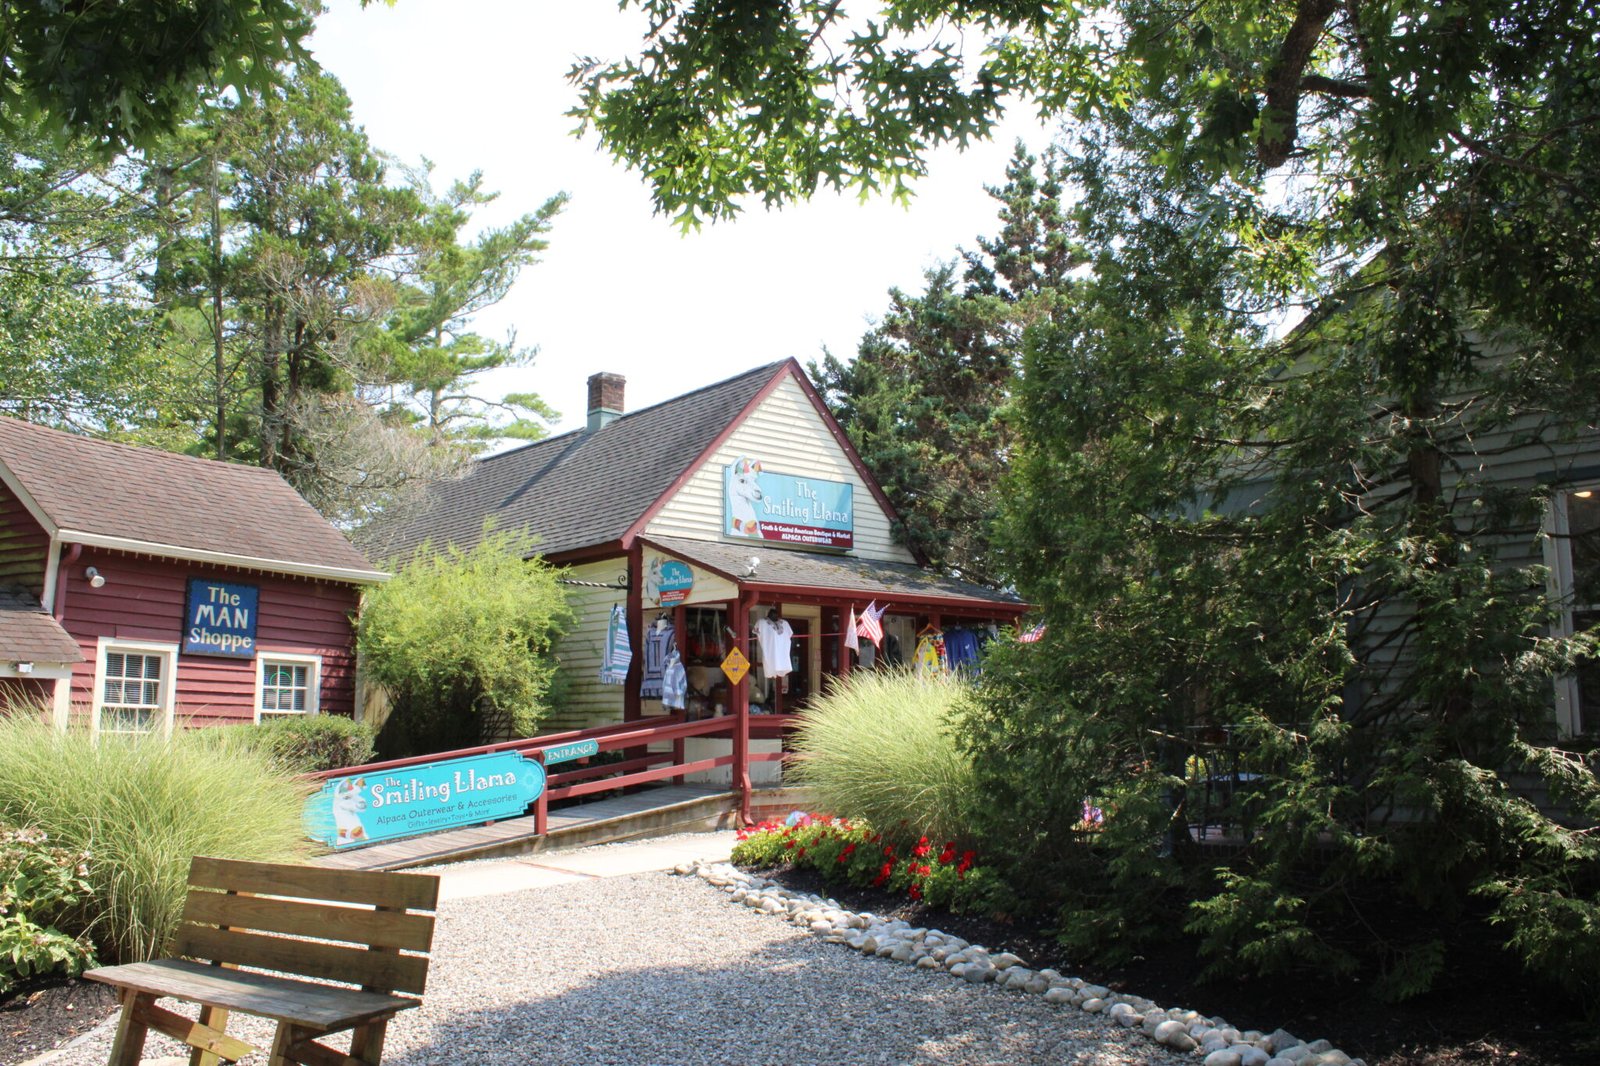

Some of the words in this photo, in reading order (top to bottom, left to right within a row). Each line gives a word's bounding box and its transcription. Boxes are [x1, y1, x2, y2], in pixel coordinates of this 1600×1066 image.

[795, 479, 817, 500] The
[763, 495, 809, 524] Smiling
[812, 500, 849, 523] Llama
[781, 533, 801, 541] ALPACA
[207, 586, 240, 606] The
[194, 604, 249, 630] MAN
[189, 627, 252, 652] Shoppe
[548, 743, 594, 761] ENTRANCE
[371, 778, 450, 808] Smiling
[454, 768, 517, 793] Llama
[384, 777, 401, 787] The
[376, 812, 406, 825] Alpaca
[408, 804, 455, 819] Outerwear
[457, 801, 465, 810] &
[467, 793, 518, 809] Accessories
